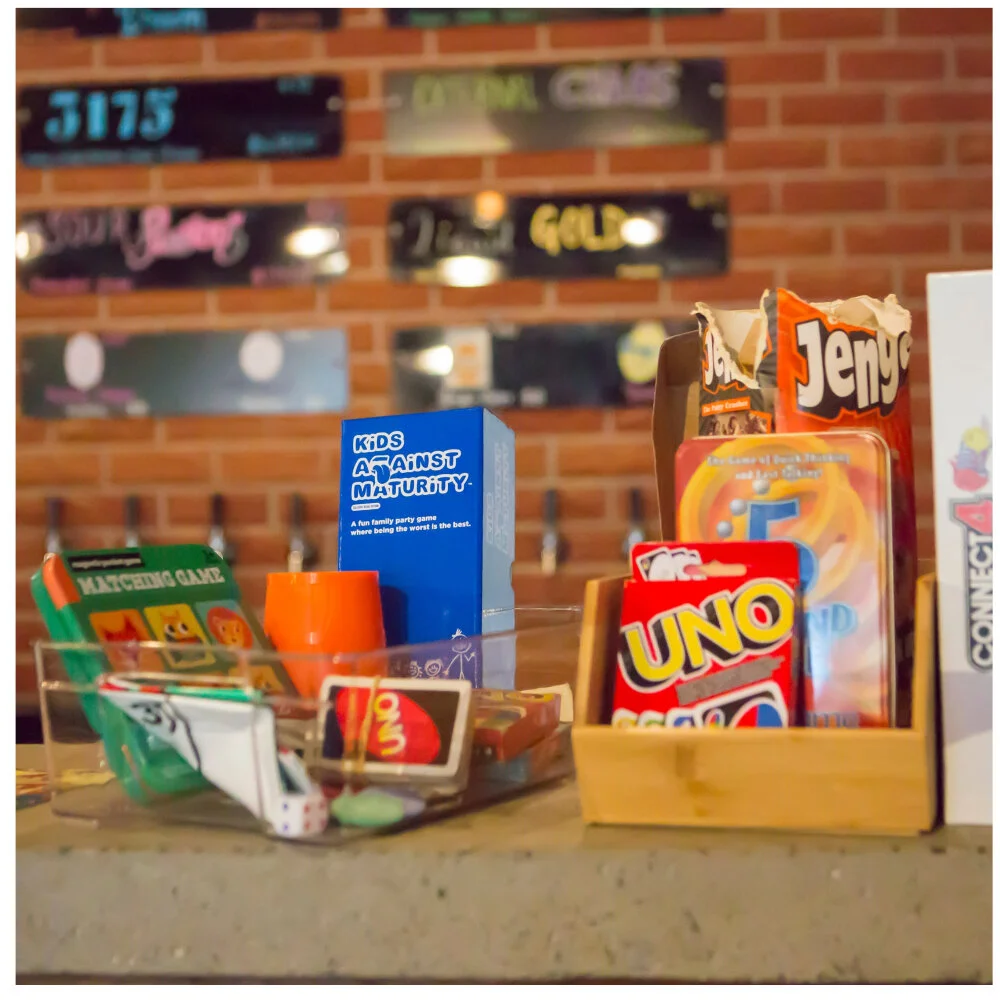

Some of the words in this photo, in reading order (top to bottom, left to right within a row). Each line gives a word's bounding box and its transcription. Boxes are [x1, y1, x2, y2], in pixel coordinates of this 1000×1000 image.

[351, 528, 372, 536] where
[374, 526, 394, 535] being
[410, 524, 430, 532] worst
[439, 522, 451, 530] the
[453, 521, 471, 529] best.
[358, 519, 370, 527] fun
[372, 517, 394, 526] family
[396, 516, 415, 525] party
[417, 515, 437, 523] game
[77, 570, 176, 596] MATCHING
[175, 566, 225, 587] GAME
[619, 577, 796, 692] UNO
